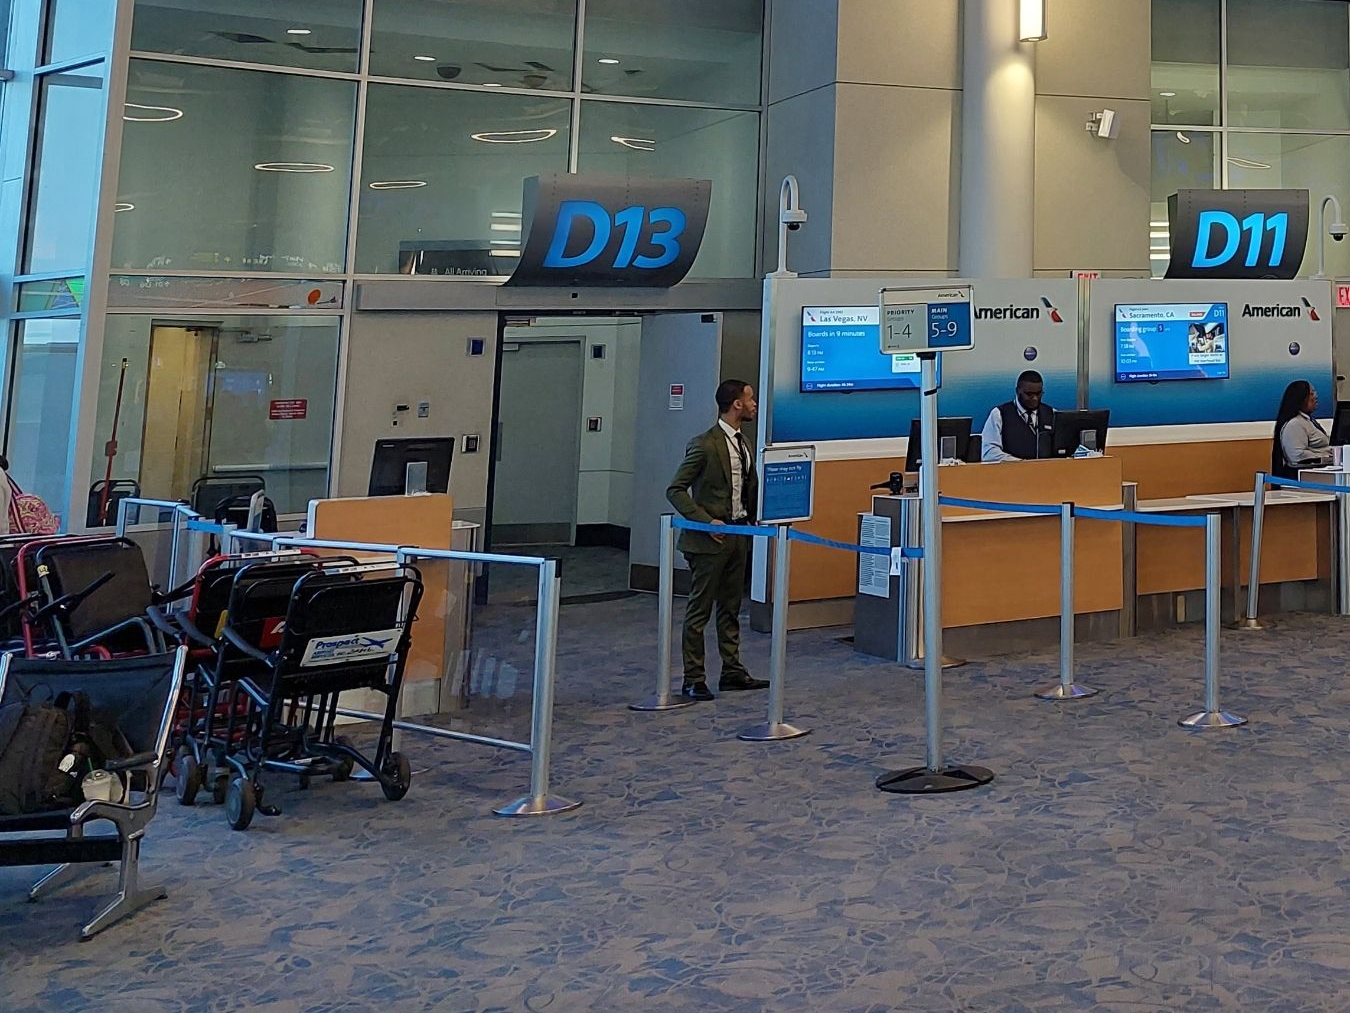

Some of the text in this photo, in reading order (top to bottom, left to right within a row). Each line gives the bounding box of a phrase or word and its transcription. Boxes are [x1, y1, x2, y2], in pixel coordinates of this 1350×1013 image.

[543, 200, 687, 269] D13
[1191, 210, 1288, 268] D11
[1213, 309, 1225, 318] D11
[1242, 303, 1300, 318] American
[315, 638, 359, 650] Prospect
